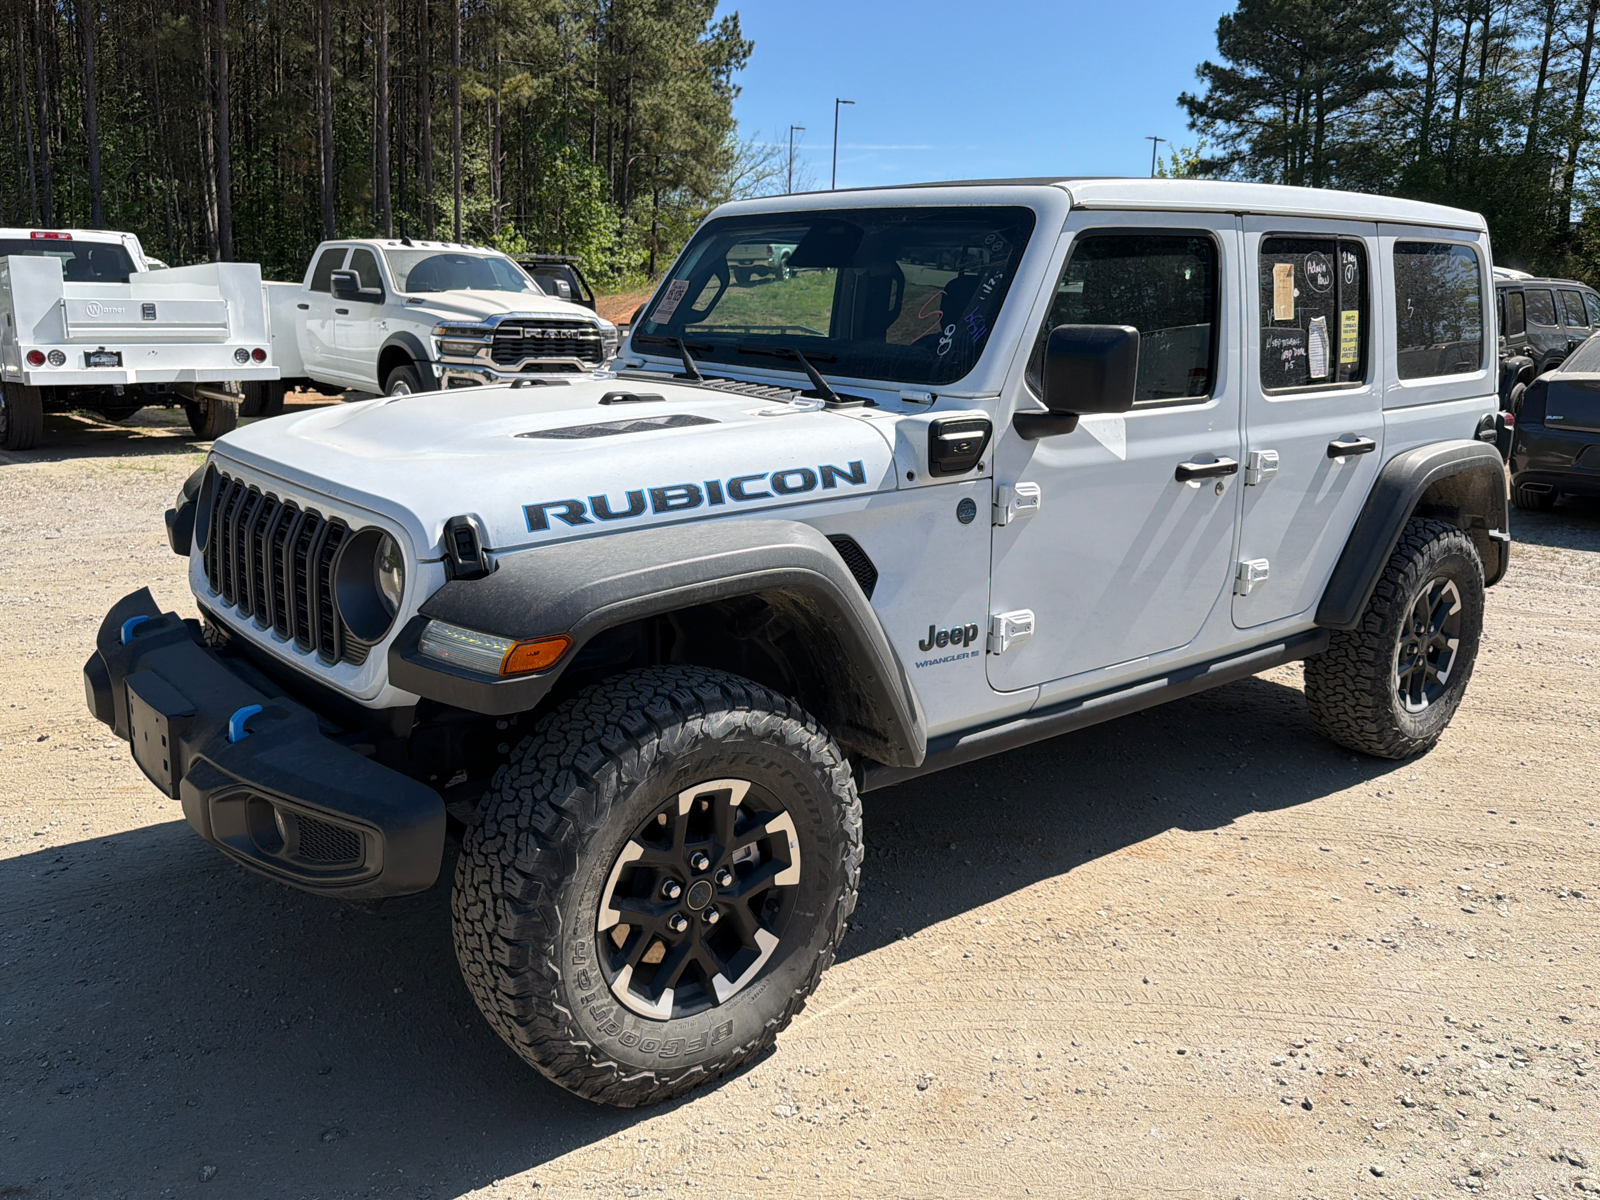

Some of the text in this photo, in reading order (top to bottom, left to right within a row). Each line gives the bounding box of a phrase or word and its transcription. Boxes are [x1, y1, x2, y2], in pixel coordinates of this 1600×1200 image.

[86, 301, 126, 318] Warner
[524, 328, 578, 339] RAM
[521, 460, 867, 533] RUBICON
[919, 622, 979, 652] Jeep
[915, 652, 969, 669] WRANGLER
[571, 940, 734, 1058] BFGoodrich
